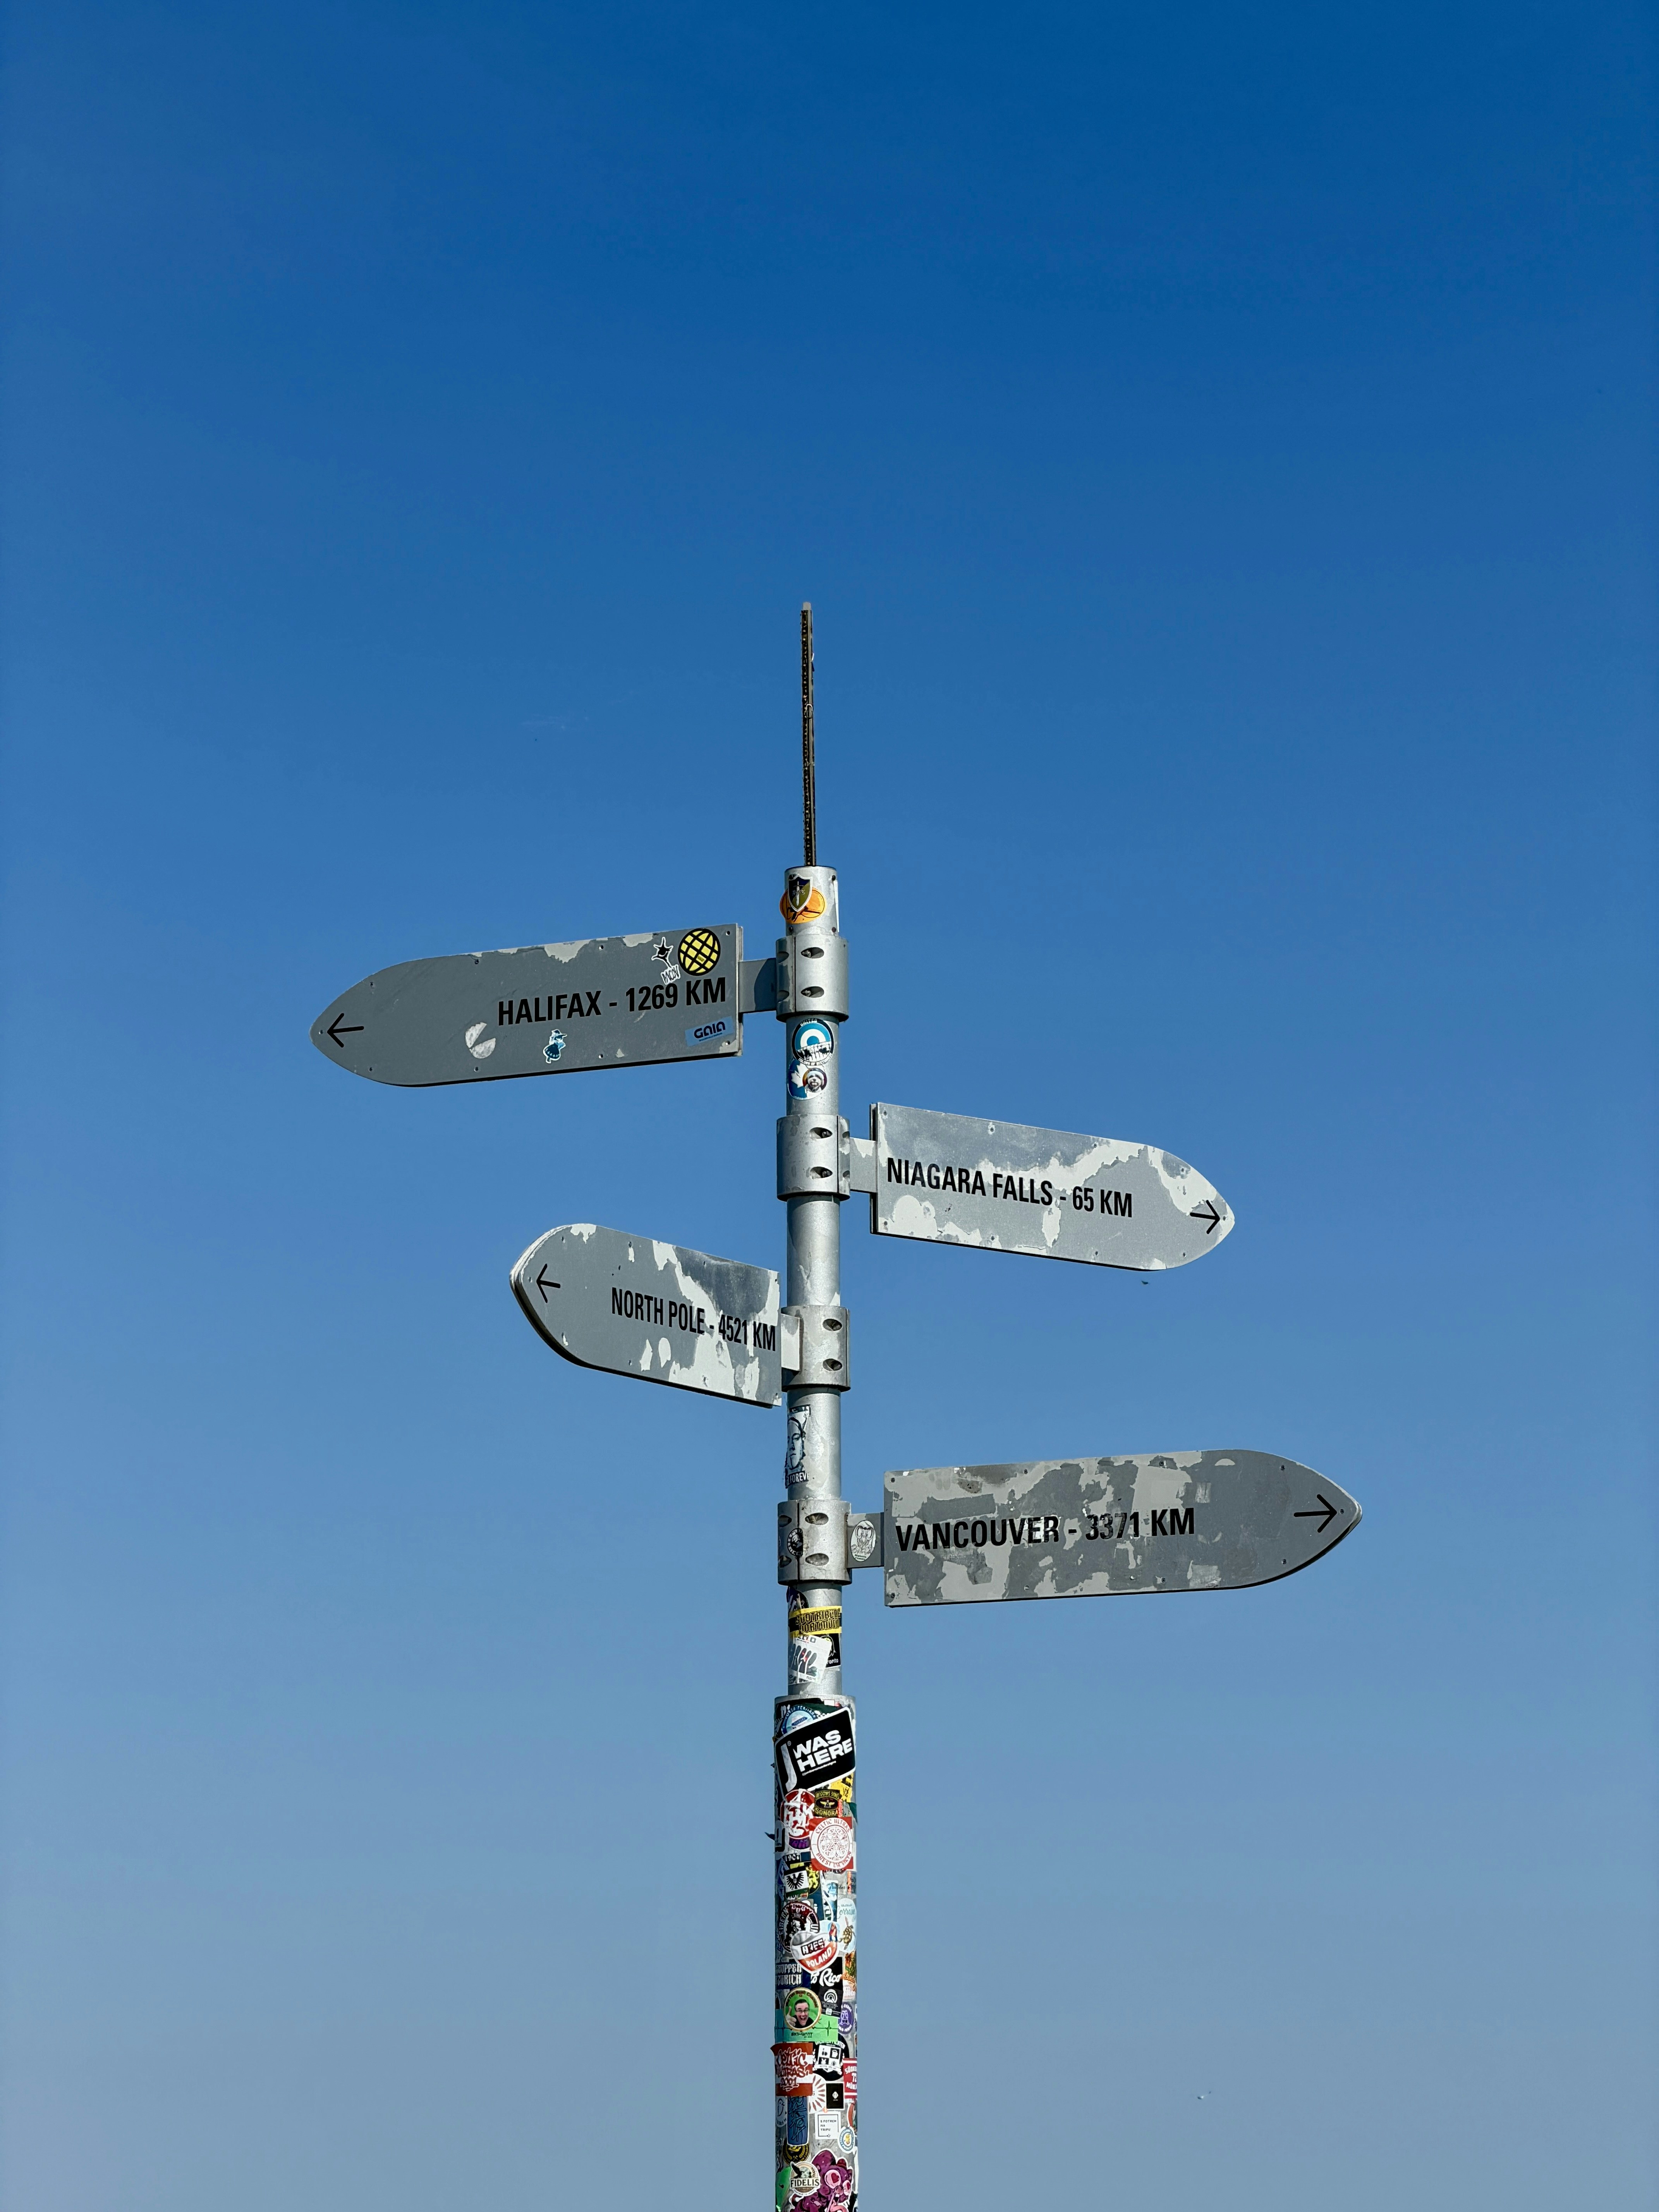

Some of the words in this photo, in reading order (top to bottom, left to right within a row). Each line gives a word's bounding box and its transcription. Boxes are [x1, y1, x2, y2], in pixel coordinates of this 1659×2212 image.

[498, 990, 601, 1026] HALIFAX
[626, 983, 678, 1012] 1269
[686, 977, 725, 1006] KM
[694, 1021, 726, 1039] GAIA
[888, 1158, 986, 1196] NIAGARA
[993, 1173, 1053, 1206] FALLS
[1073, 1186, 1094, 1212] 65
[1100, 1189, 1132, 1218] KM
[612, 1287, 663, 1326] NORTH
[669, 1300, 705, 1334] POLE
[718, 1314, 747, 1345] 4521
[753, 1321, 776, 1352] KM
[895, 1516, 1059, 1551] VANCOUVER
[1085, 1511, 1139, 1540] 3371
[1151, 1508, 1194, 1536] KM
[793, 1730, 841, 1759] WAS
[797, 1738, 852, 1772] HERE
[815, 1808, 838, 1816] SONORA
[816, 1819, 832, 1834] CELTIC
[806, 1947, 832, 1967] POLAND
[778, 1974, 802, 1985] ZÜRICH
[819, 1968, 842, 1987] Rico
[780, 2077, 799, 2088] 2001
[790, 2179, 819, 2187] FIDELIS
